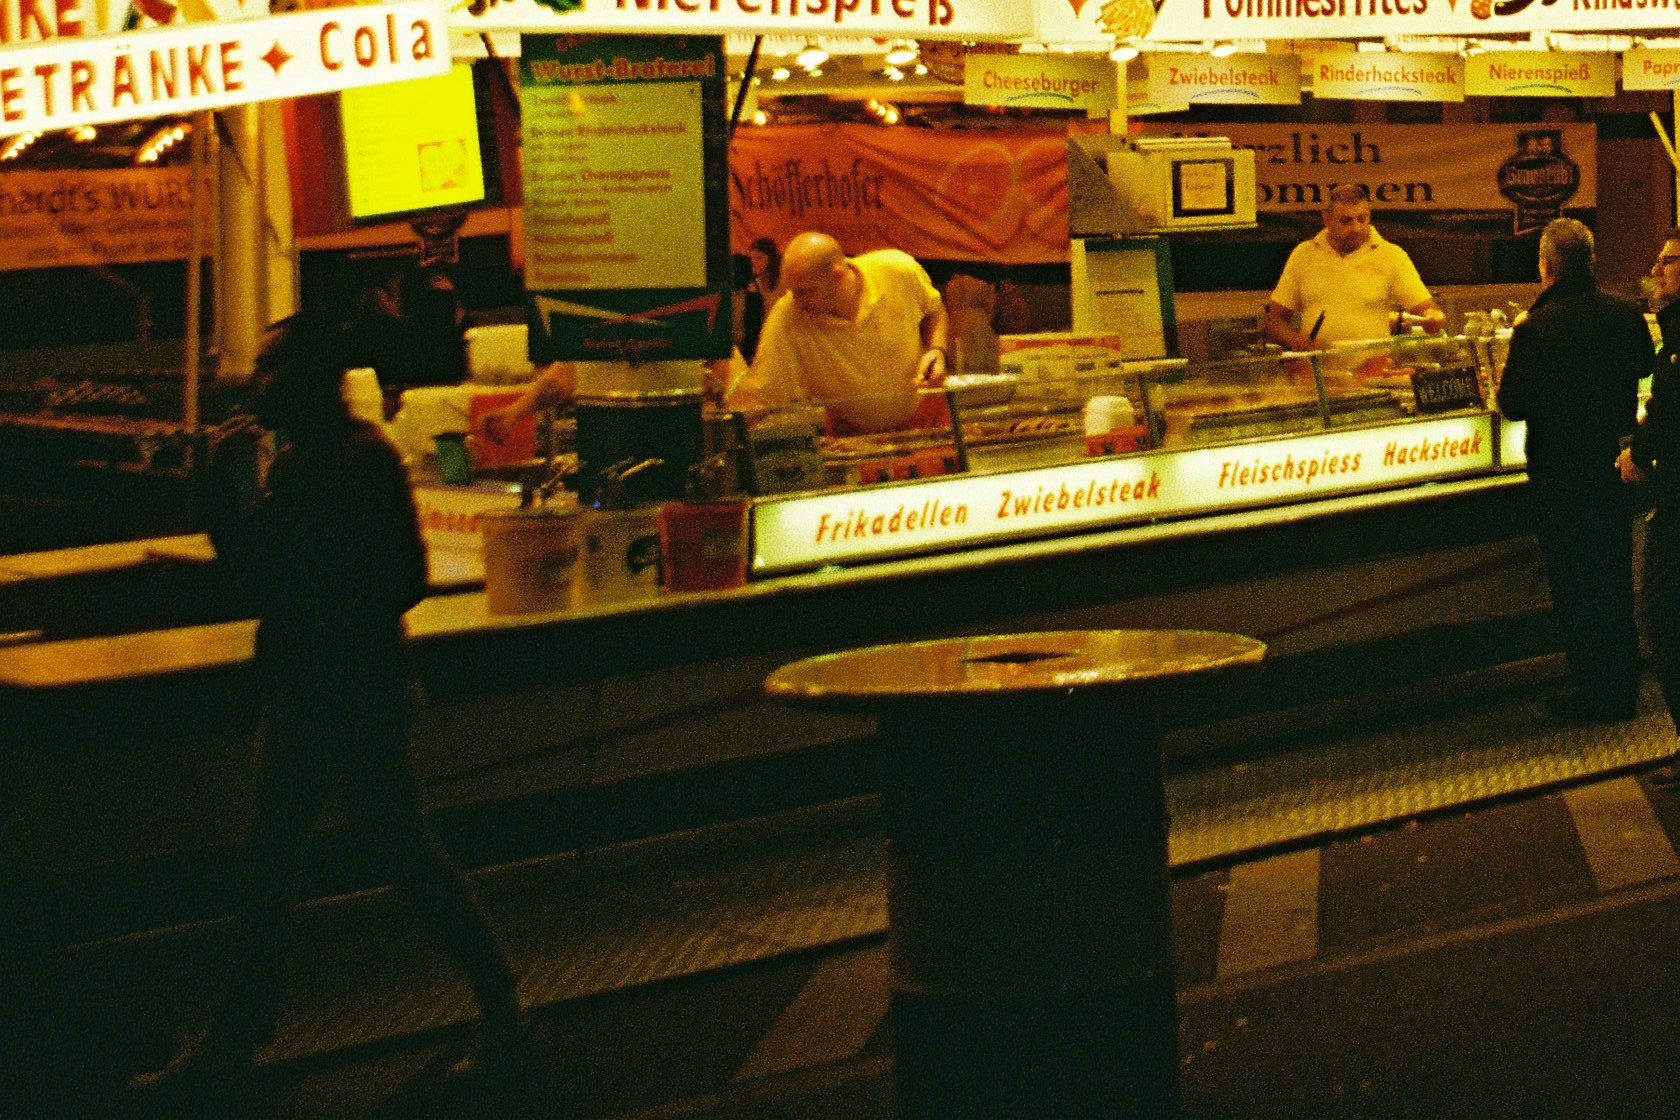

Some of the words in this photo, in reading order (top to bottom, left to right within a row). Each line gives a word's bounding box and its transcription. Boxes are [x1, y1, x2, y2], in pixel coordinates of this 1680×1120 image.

[317, 11, 435, 72] Cola
[982, 69, 1098, 94] Cheeseburger
[1168, 67, 1279, 87] Zwiebelsteak
[1318, 63, 1457, 86] Rinderhacksteak
[1489, 62, 1592, 82] Nierenspieß
[815, 499, 969, 545] Frikadellen
[997, 469, 1161, 520] Zwiebelsteak
[1218, 448, 1362, 491] Fleischspiess
[1382, 429, 1484, 466] Hacksteak
